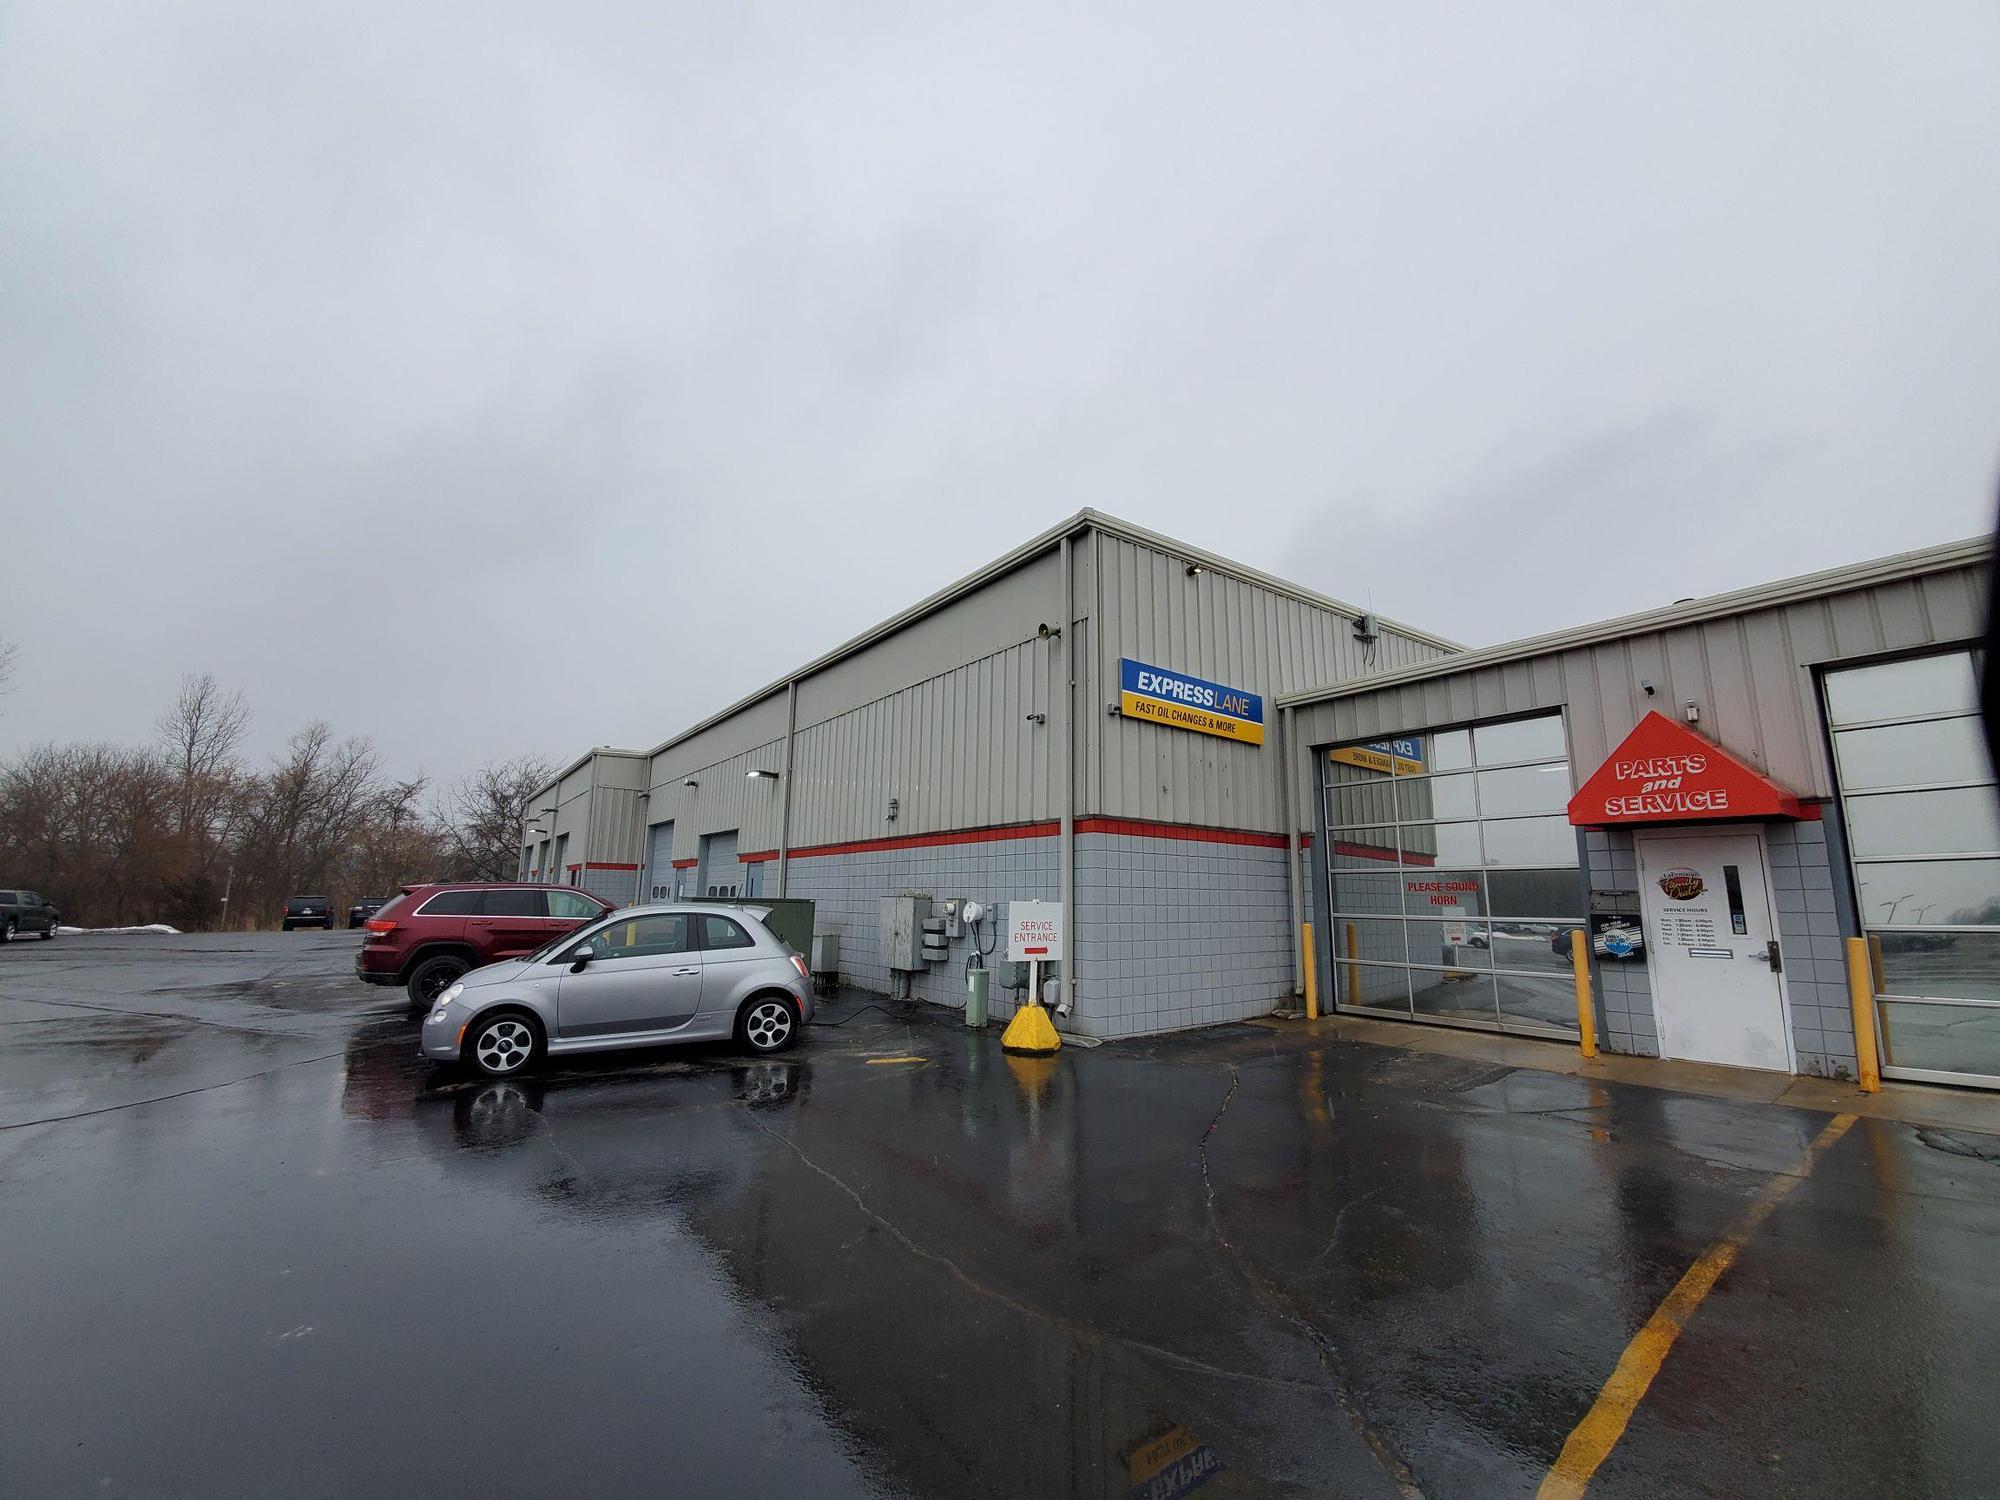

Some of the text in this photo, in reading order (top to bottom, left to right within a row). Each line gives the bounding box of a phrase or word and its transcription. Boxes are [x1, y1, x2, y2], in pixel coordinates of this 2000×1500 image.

[1135, 701, 1237, 733] FAST OIL CHANGES & MORE
[1615, 754, 1707, 780] PARTS
[1641, 776, 1682, 793] and
[1605, 789, 1729, 816] SERVICE
[1407, 882, 1479, 892] PLEASE SOUND
[1430, 895, 1457, 905] HORN
[1020, 921, 1053, 931] SERVICE
[1014, 932, 1057, 943] ENTRANCE
